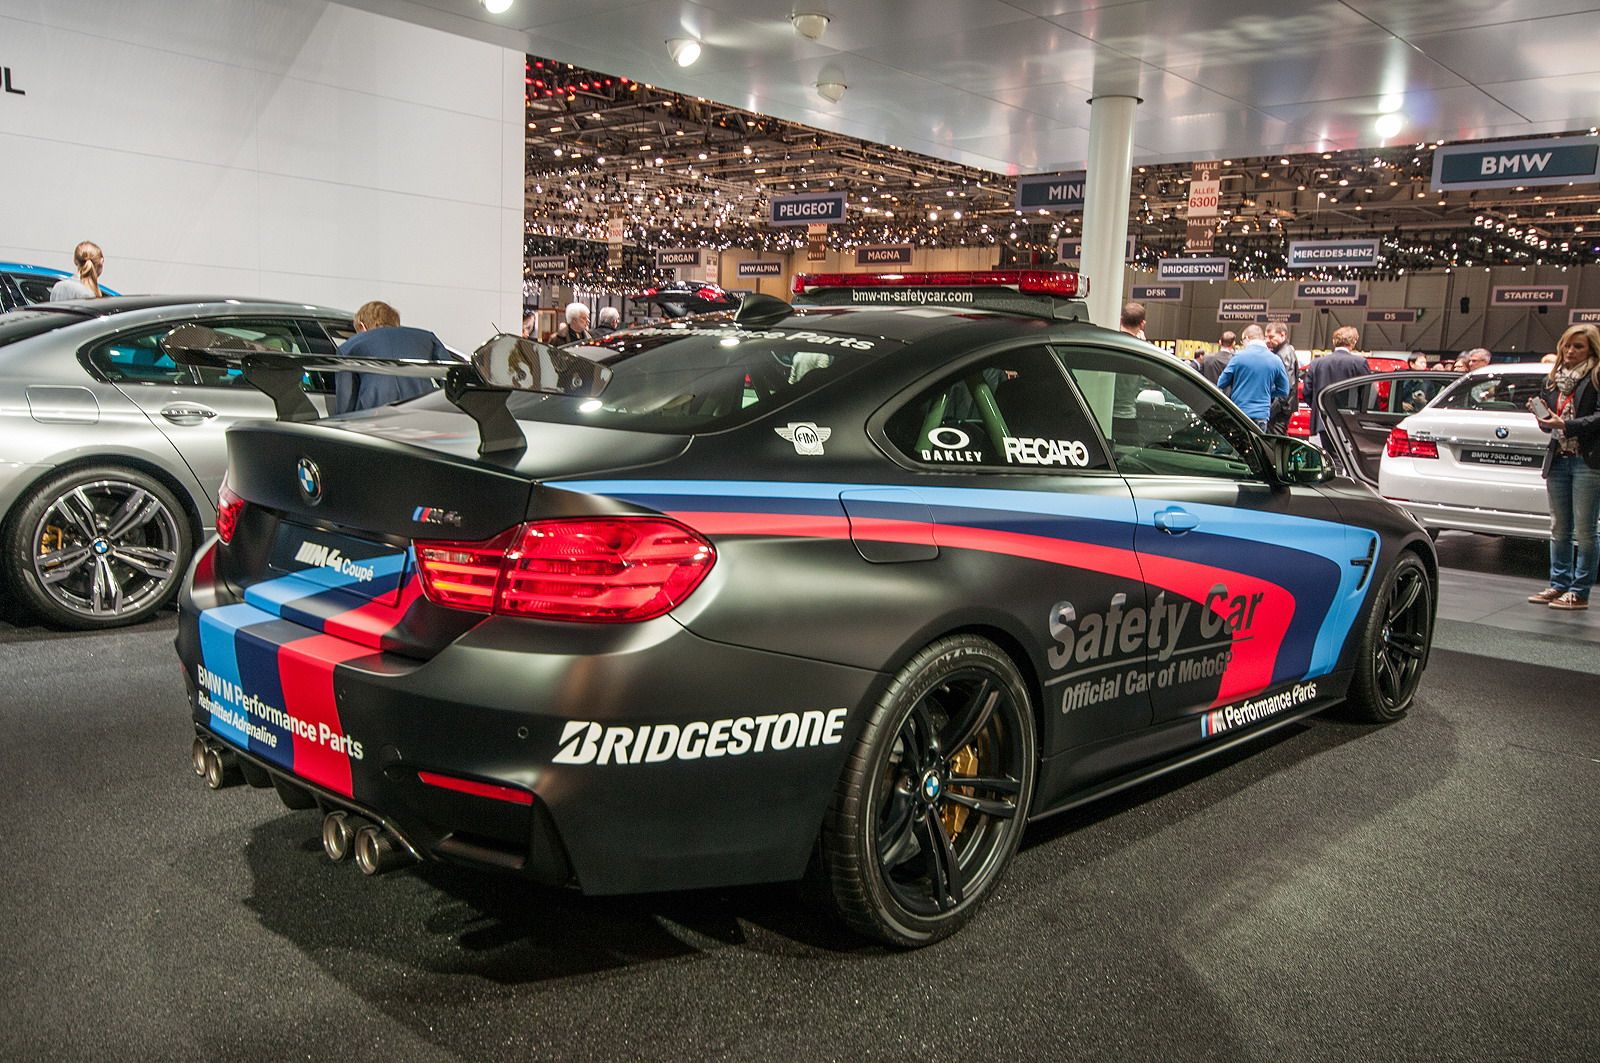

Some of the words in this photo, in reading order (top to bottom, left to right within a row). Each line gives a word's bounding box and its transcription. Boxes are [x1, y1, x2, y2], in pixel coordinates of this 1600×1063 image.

[1194, 162, 1219, 171] HALLE
[1480, 152, 1552, 176] BMW
[1201, 170, 1210, 181] 6
[1189, 196, 1217, 208] 6300
[779, 201, 836, 217] PEUGEOT
[662, 254, 695, 264] MORGAN
[867, 250, 900, 260] MAGNA
[1293, 247, 1374, 259] MERCEDES-BENZ
[740, 265, 756, 273] BMW
[756, 264, 779, 272] ALPINA
[1162, 264, 1225, 275] BRIDGESTONE
[851, 288, 974, 304] bmw-m-safetycar.com
[1146, 289, 1167, 297] DFSK
[1304, 286, 1349, 295] CARLSSON
[1503, 291, 1554, 300] STARTECH
[1384, 312, 1396, 320] DS
[785, 331, 876, 350] Parts
[921, 449, 982, 462] OAKLEY
[1003, 437, 1090, 467] RECARO
[342, 558, 374, 582] Coupé
[1047, 590, 1191, 670] Safety
[1200, 583, 1264, 640] Car
[1061, 679, 1120, 715] Official
[1125, 669, 1155, 692] Car
[1158, 664, 1175, 688] of
[1178, 651, 1232, 683] MotoGP
[197, 663, 223, 697] BMW
[223, 680, 234, 704] M
[235, 685, 318, 743] Performance
[318, 722, 364, 760] Parts
[1224, 691, 1292, 729] Performance
[1292, 682, 1317, 705] Parts
[198, 690, 233, 724] Retrofitted
[232, 710, 278, 748] Adrenaline
[551, 708, 848, 765] BRIDGESTONE
